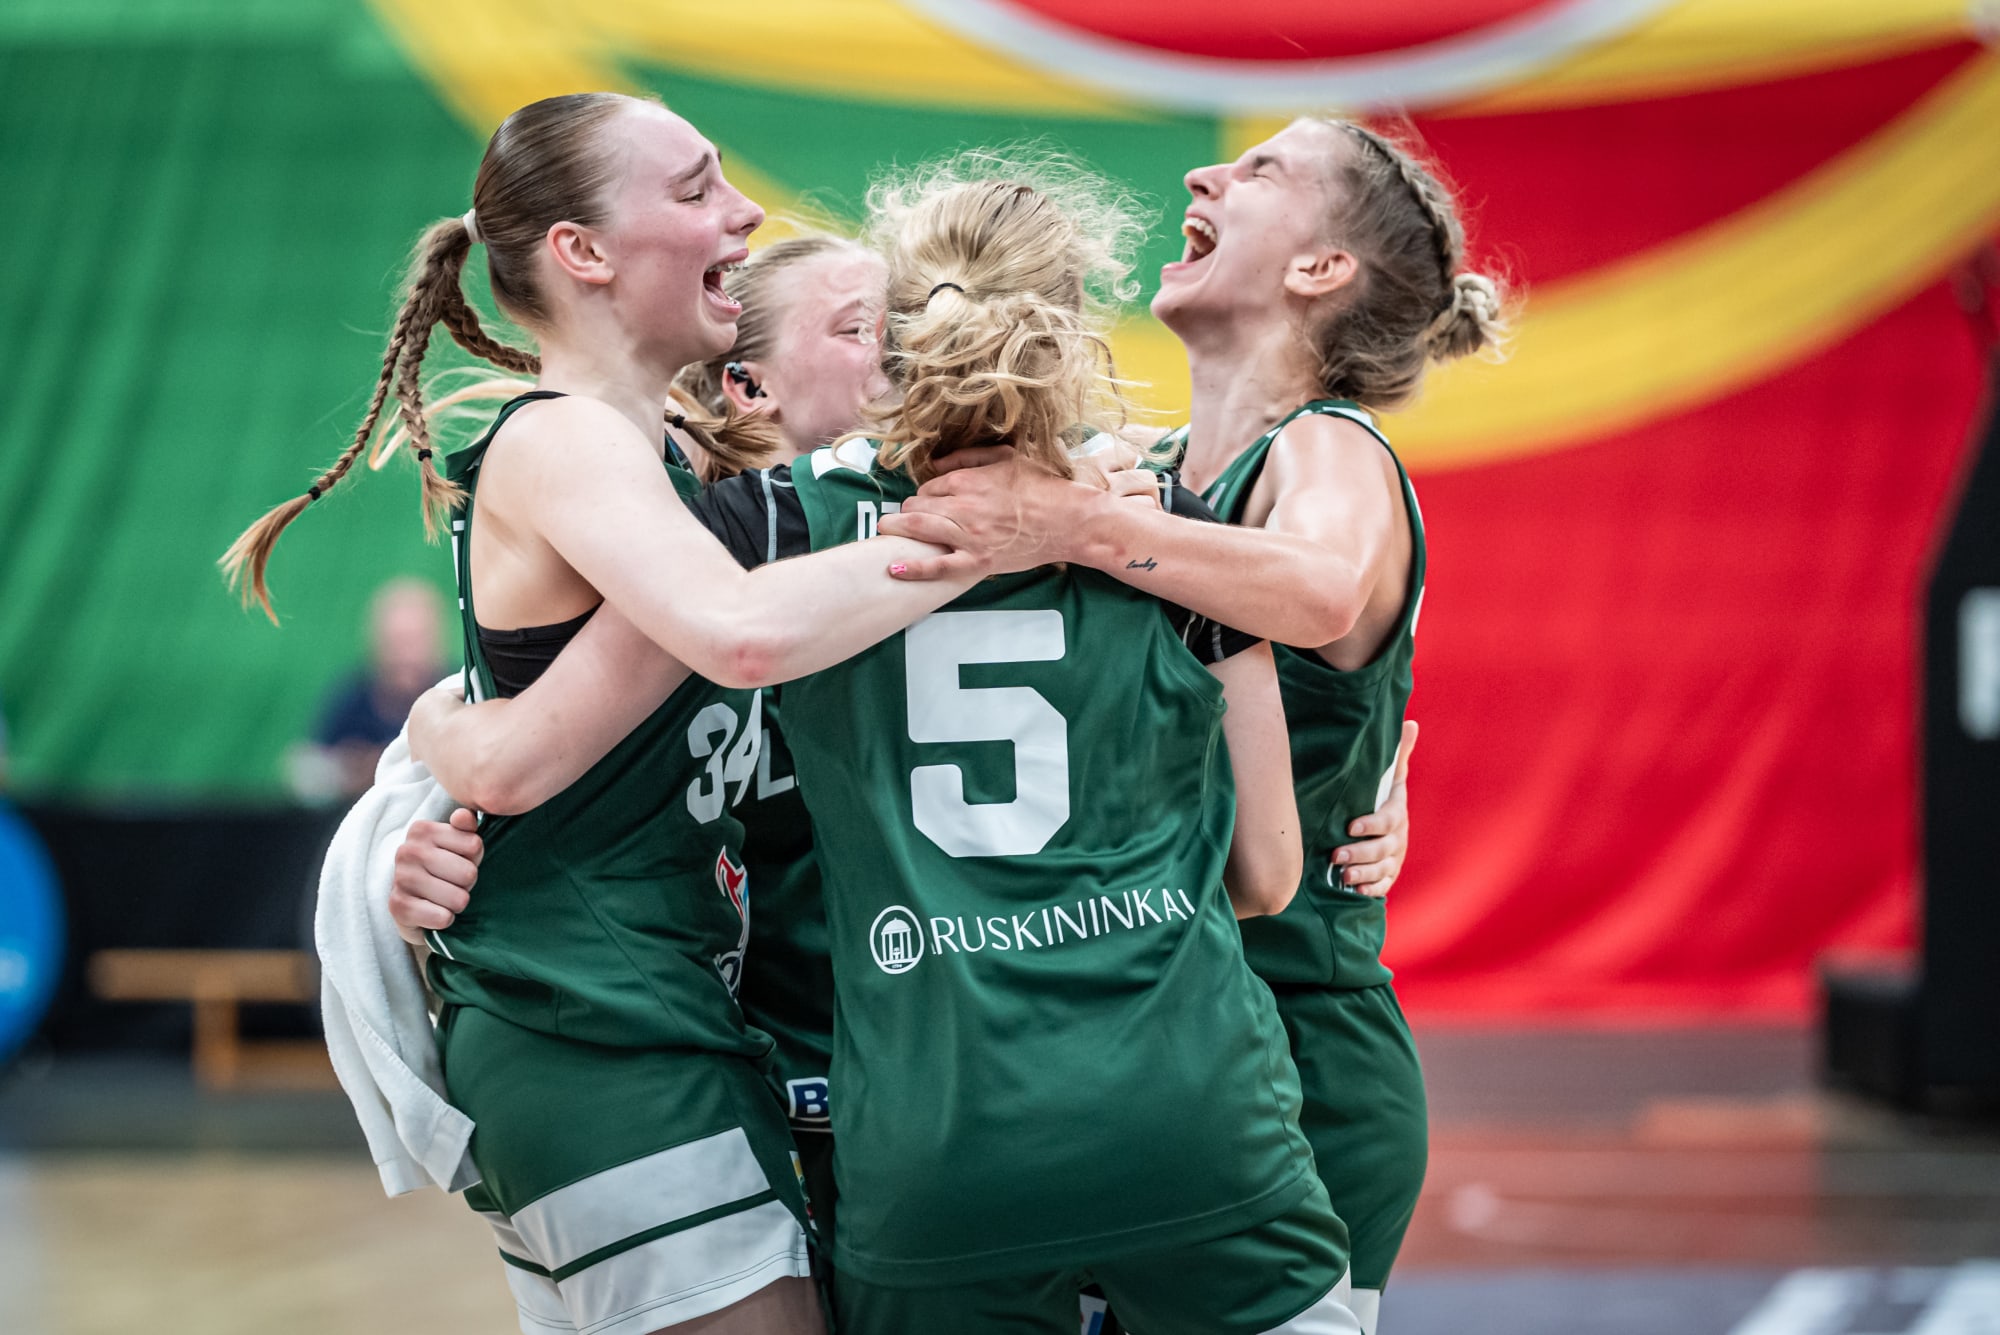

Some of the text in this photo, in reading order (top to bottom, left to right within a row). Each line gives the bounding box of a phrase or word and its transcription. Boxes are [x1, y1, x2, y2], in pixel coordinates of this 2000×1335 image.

[686, 687, 763, 825] 34
[905, 609, 1070, 858] 5
[930, 888, 1196, 956] RUSKININKAI
